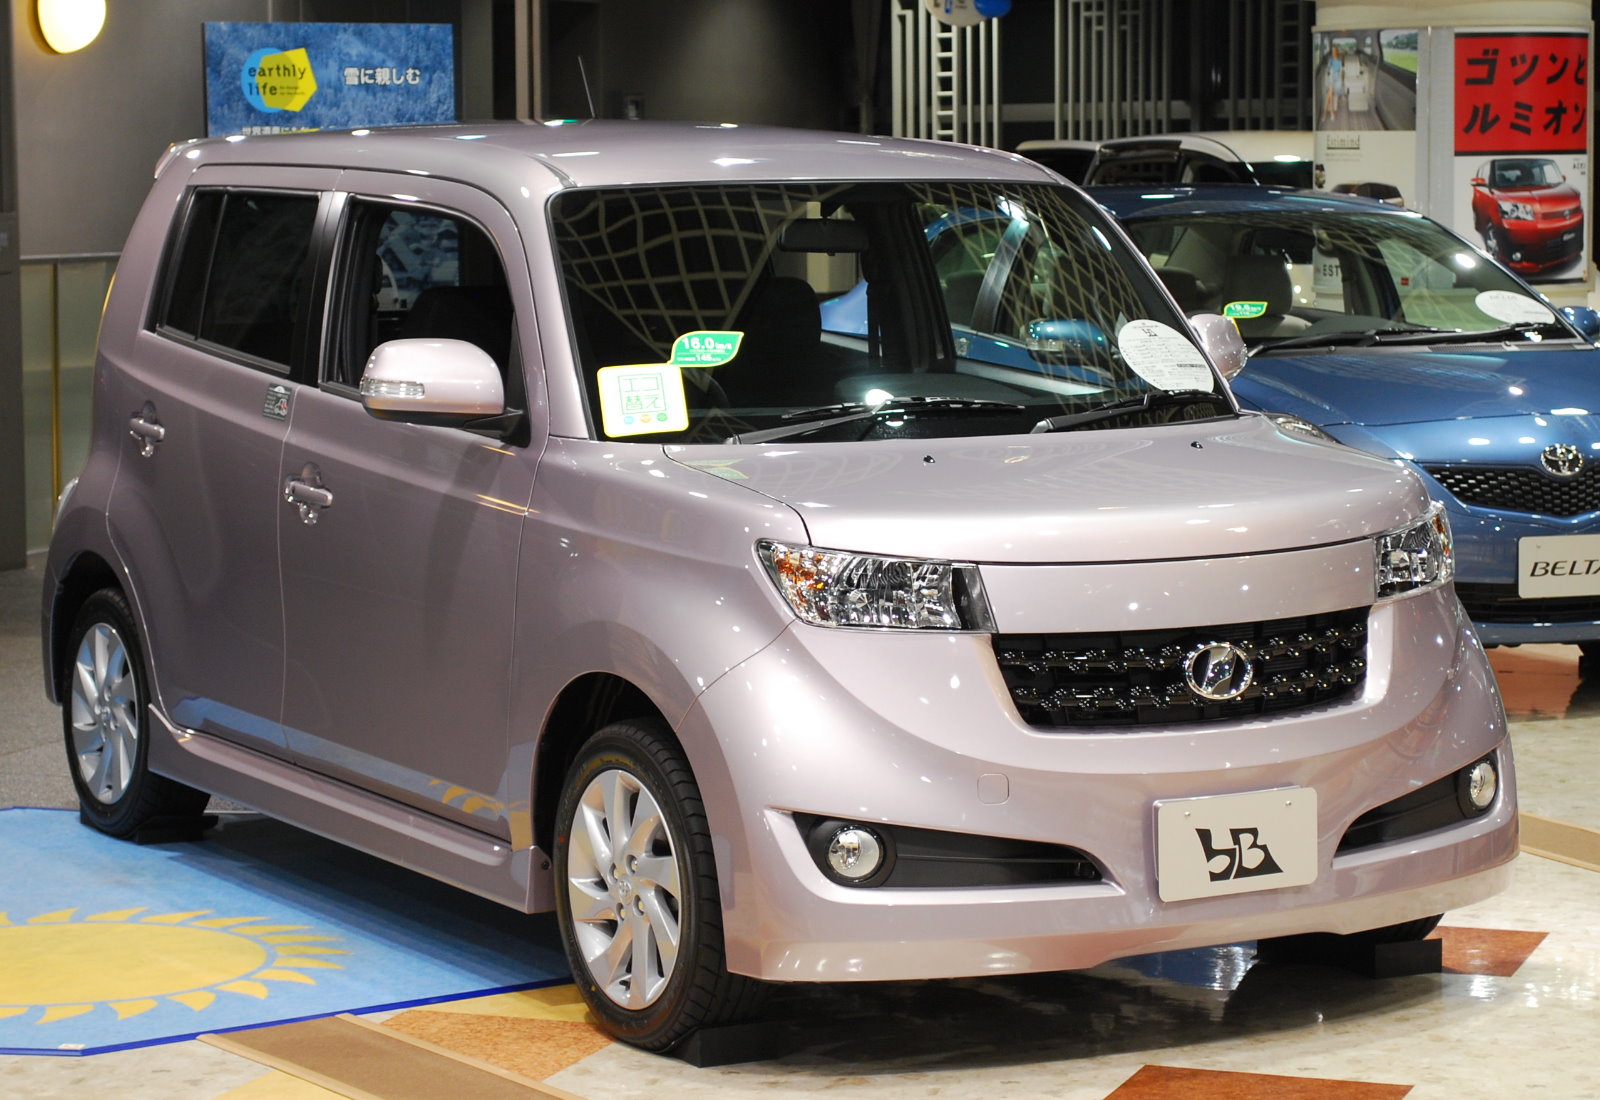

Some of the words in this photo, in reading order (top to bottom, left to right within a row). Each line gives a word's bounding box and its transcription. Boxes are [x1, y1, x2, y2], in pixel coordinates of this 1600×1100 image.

[248, 64, 306, 80] earthly
[343, 66, 421, 86] 雪に親しむ
[1464, 48, 1585, 86] ゴツンと
[248, 82, 278, 96] life
[1462, 99, 1586, 136] ルミオン
